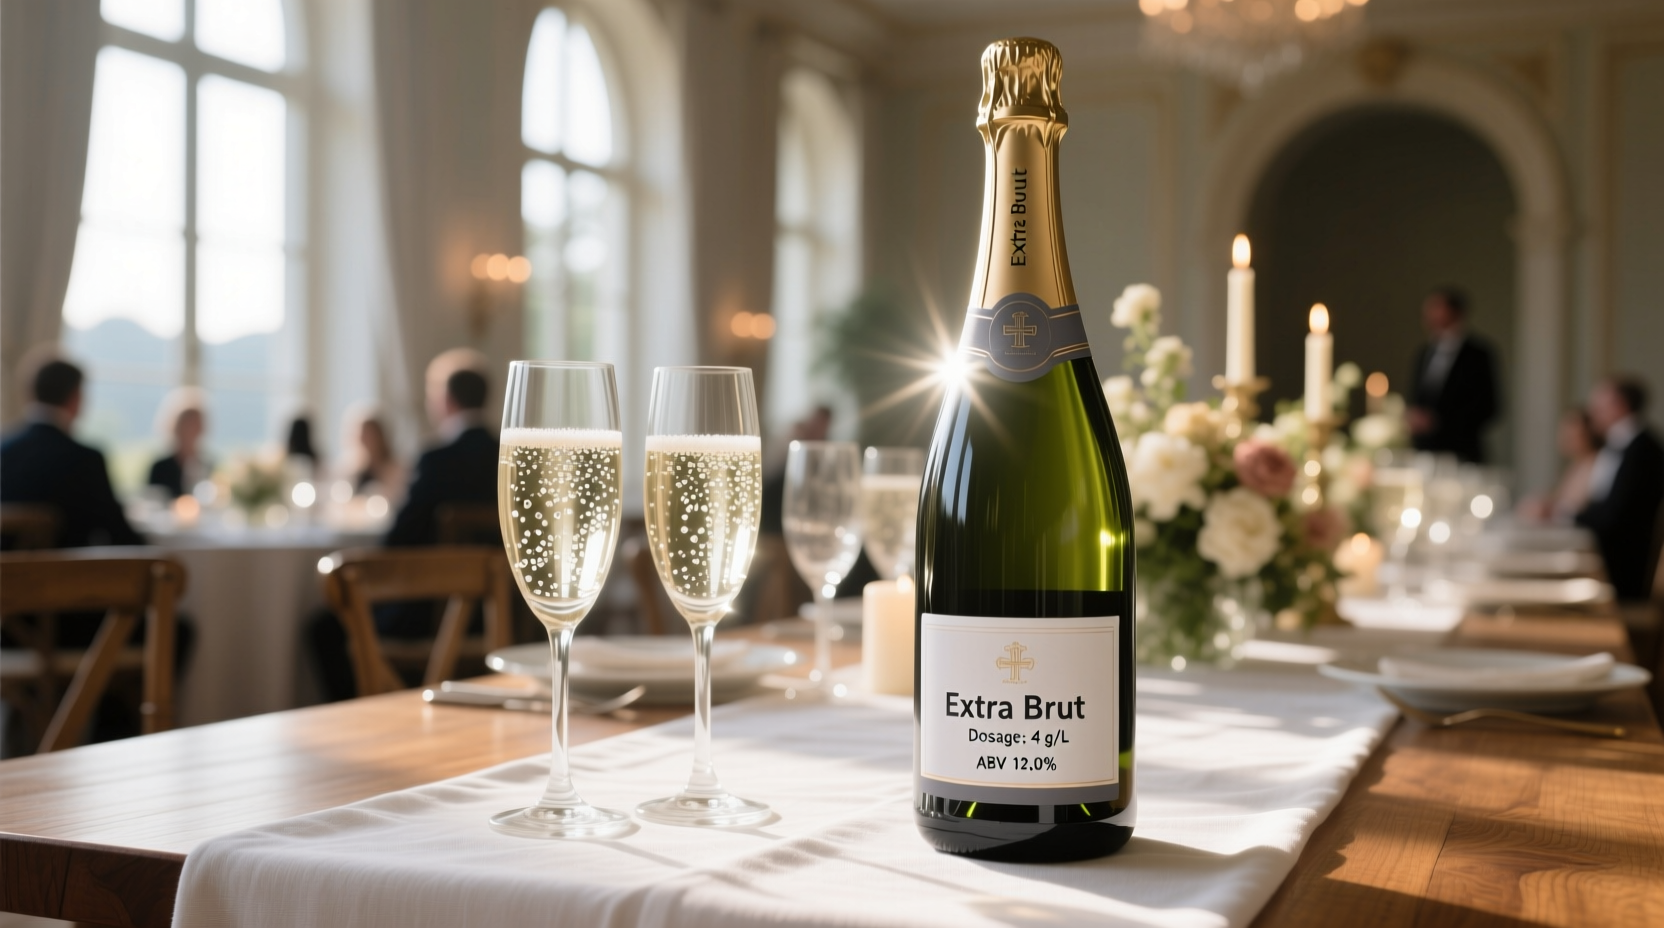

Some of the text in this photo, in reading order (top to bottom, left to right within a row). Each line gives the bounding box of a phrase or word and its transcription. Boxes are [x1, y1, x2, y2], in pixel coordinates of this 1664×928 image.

[946, 692, 1085, 720] Extra Brut
[968, 728, 1069, 748] Dosage: 4 g/L
[976, 756, 1057, 771] ABV 12.0%
